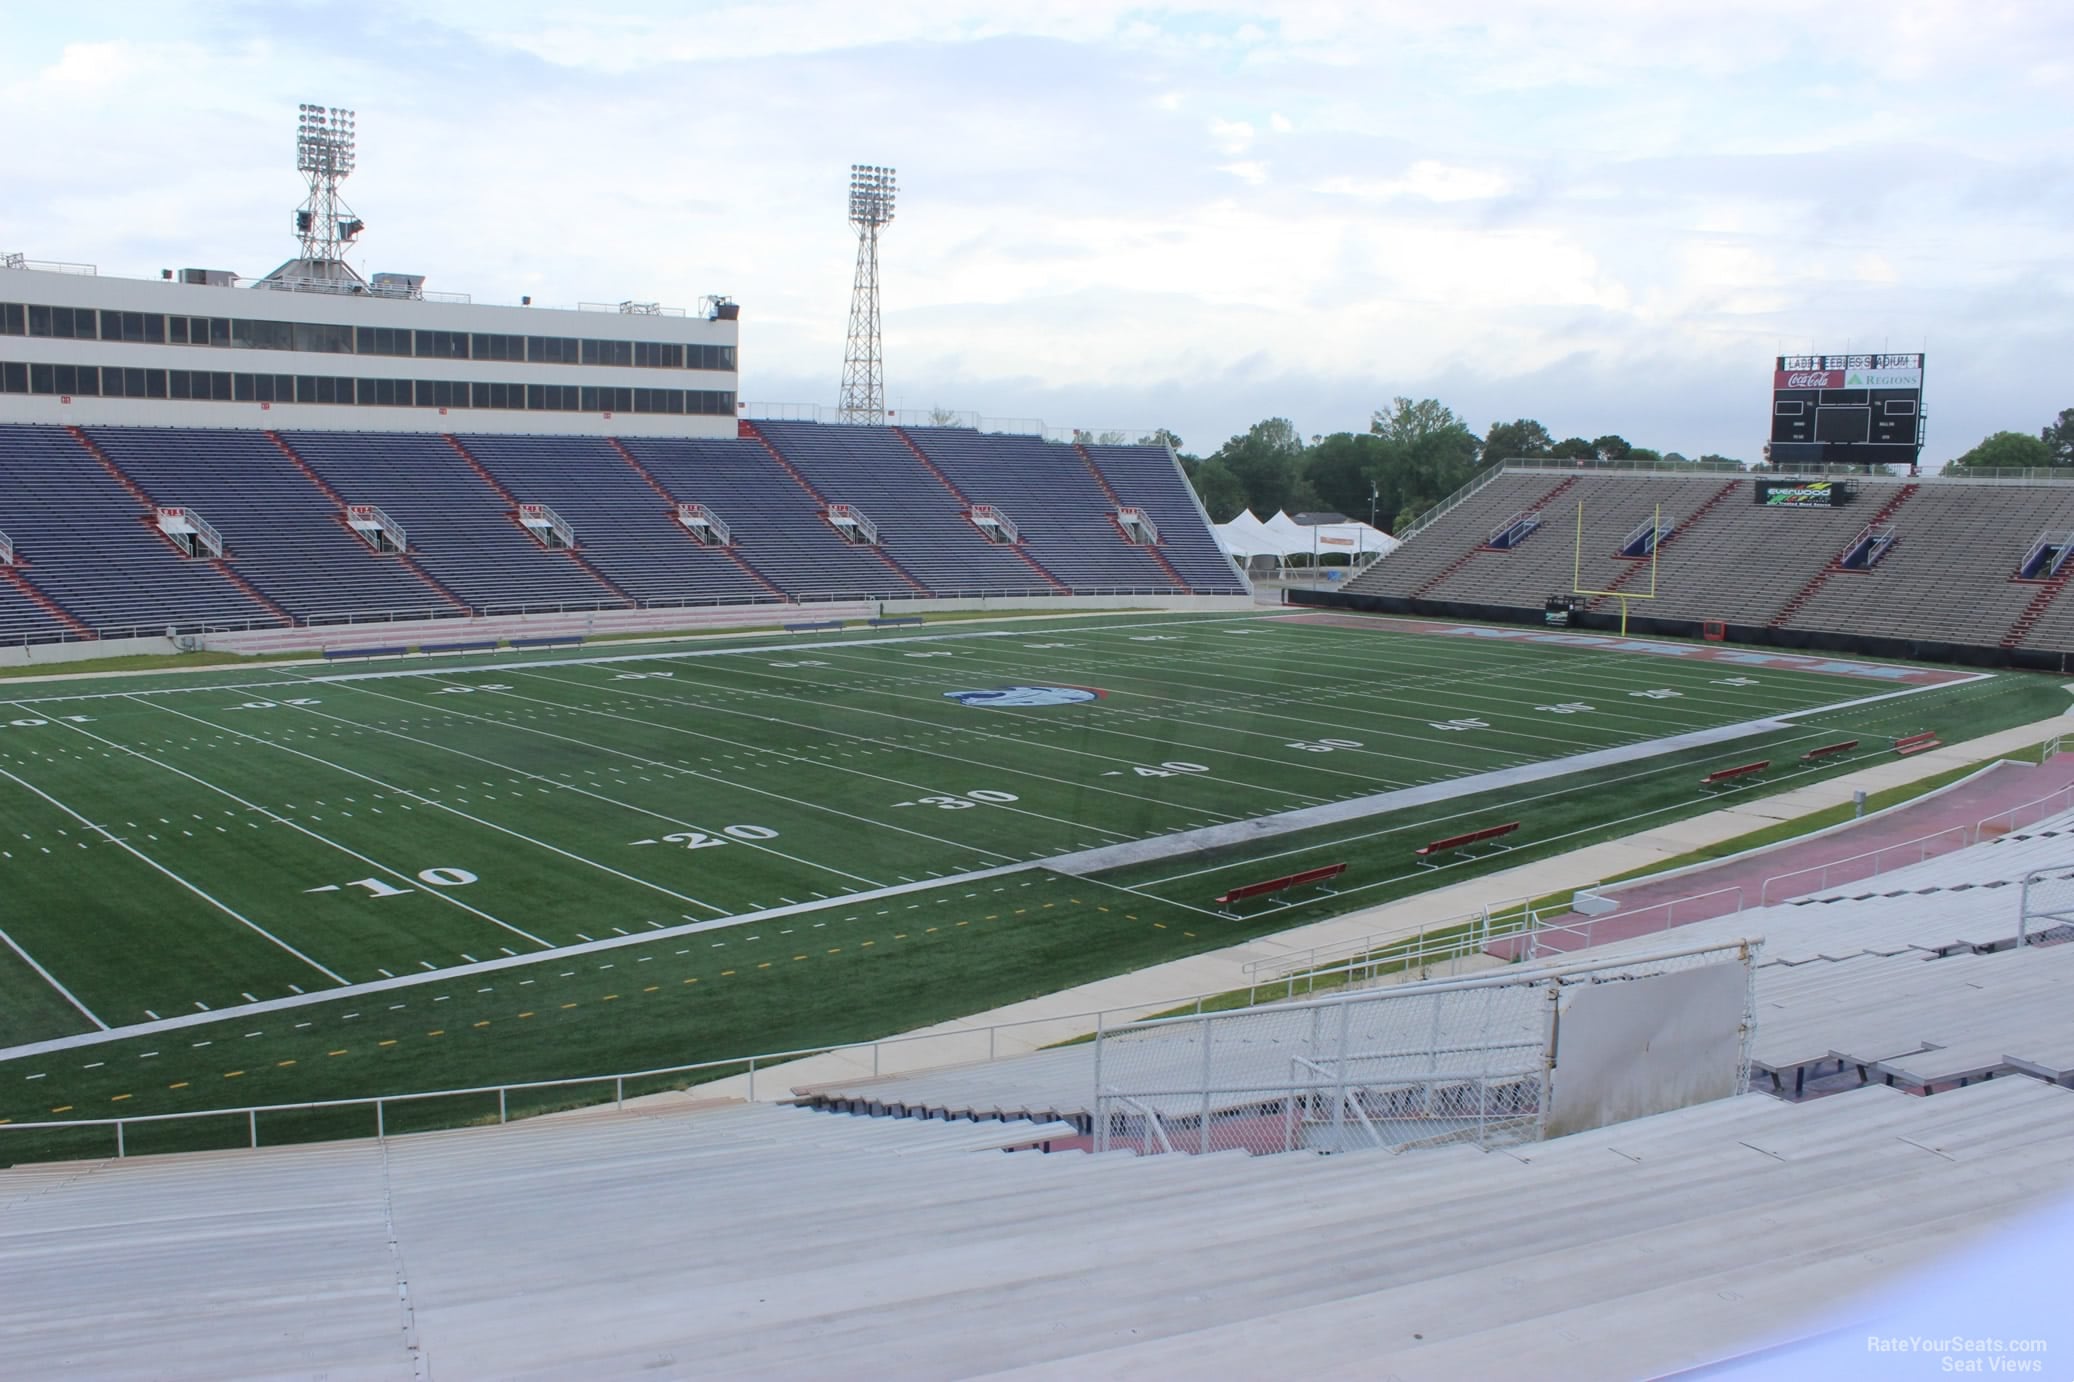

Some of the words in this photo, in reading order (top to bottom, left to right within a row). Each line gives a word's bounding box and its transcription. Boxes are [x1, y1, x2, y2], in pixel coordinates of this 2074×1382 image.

[1866, 375, 1917, 385] REGIONS
[1767, 488, 1831, 496] everwood
[1426, 627, 1929, 679] NORTH
[1428, 719, 1491, 731] 40
[1284, 738, 1364, 753] 50
[1133, 761, 1210, 778] 40
[918, 790, 1020, 810] 30
[662, 824, 780, 850] 20
[345, 867, 479, 898] 10
